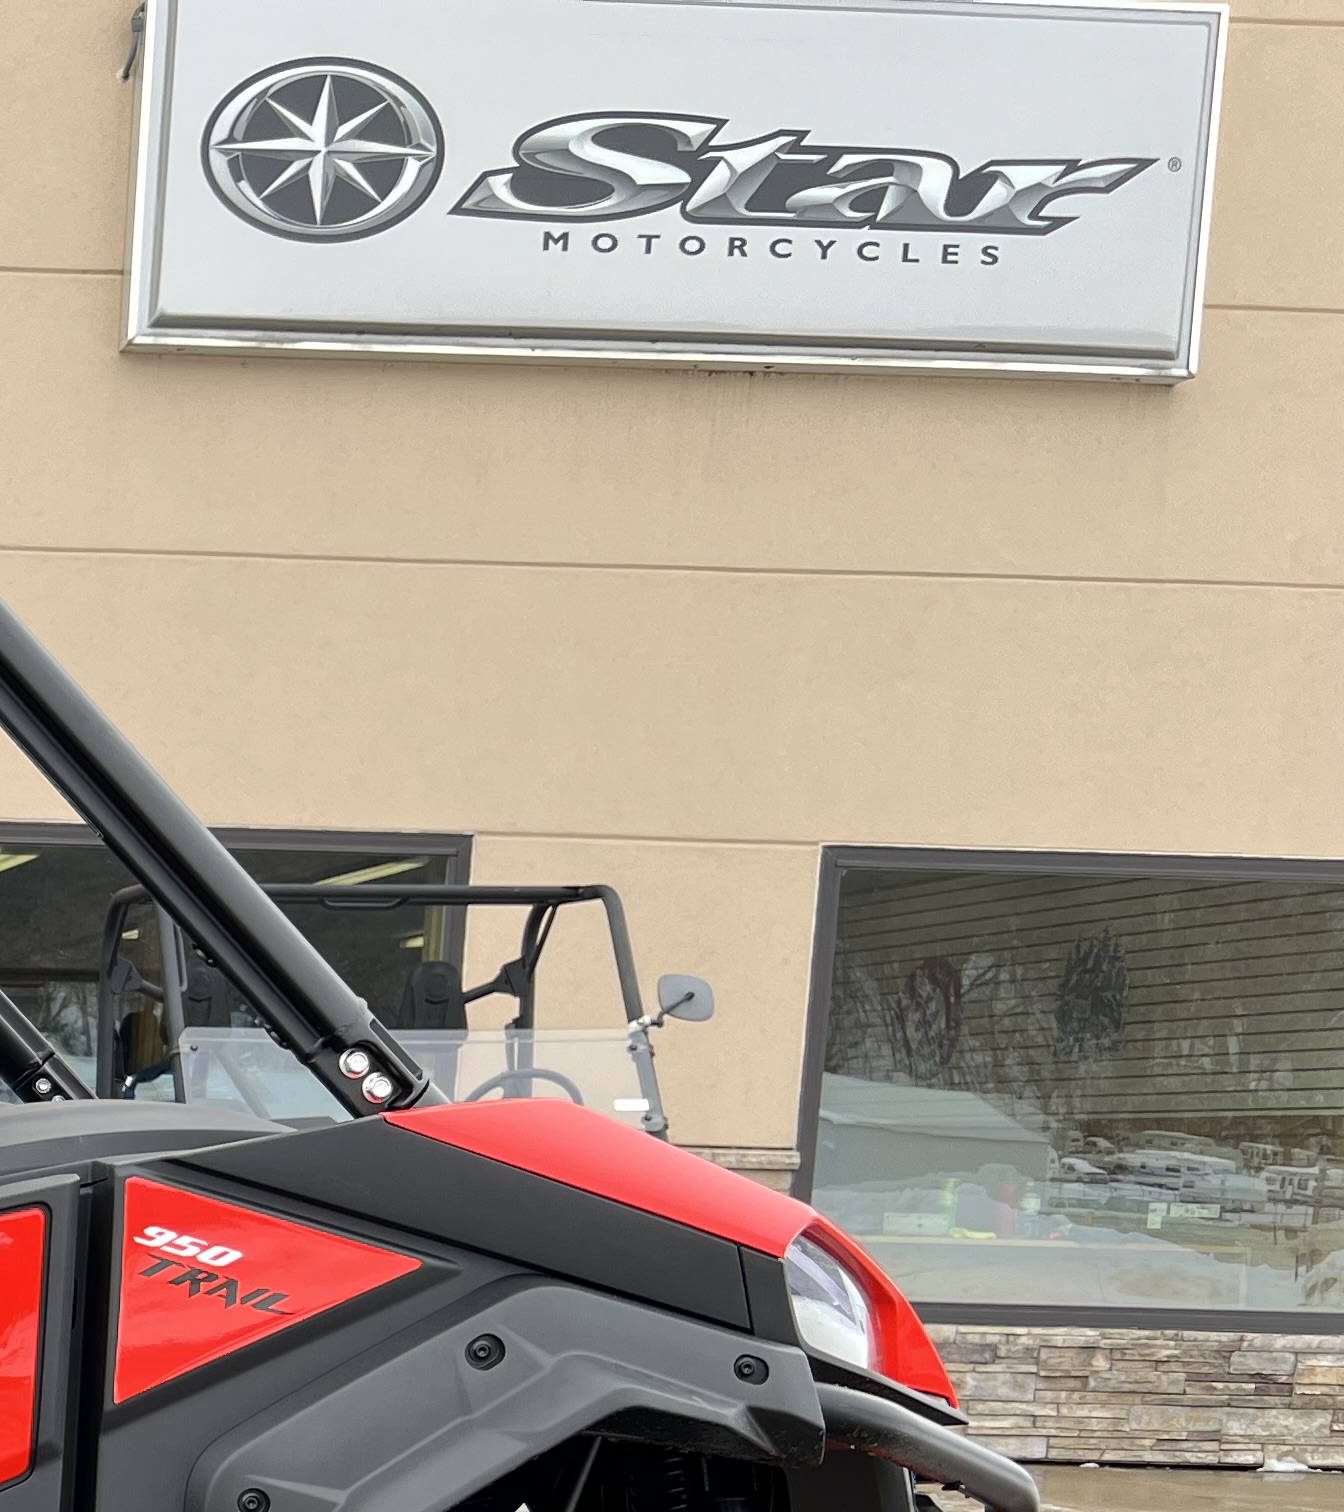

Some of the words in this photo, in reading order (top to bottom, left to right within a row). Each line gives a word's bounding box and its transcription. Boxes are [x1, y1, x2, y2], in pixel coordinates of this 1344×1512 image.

[448, 110, 1160, 232] Star
[543, 229, 1003, 267] MOTORCYCLES
[132, 1225, 244, 1267] 950
[135, 1253, 295, 1316] TRAIL
